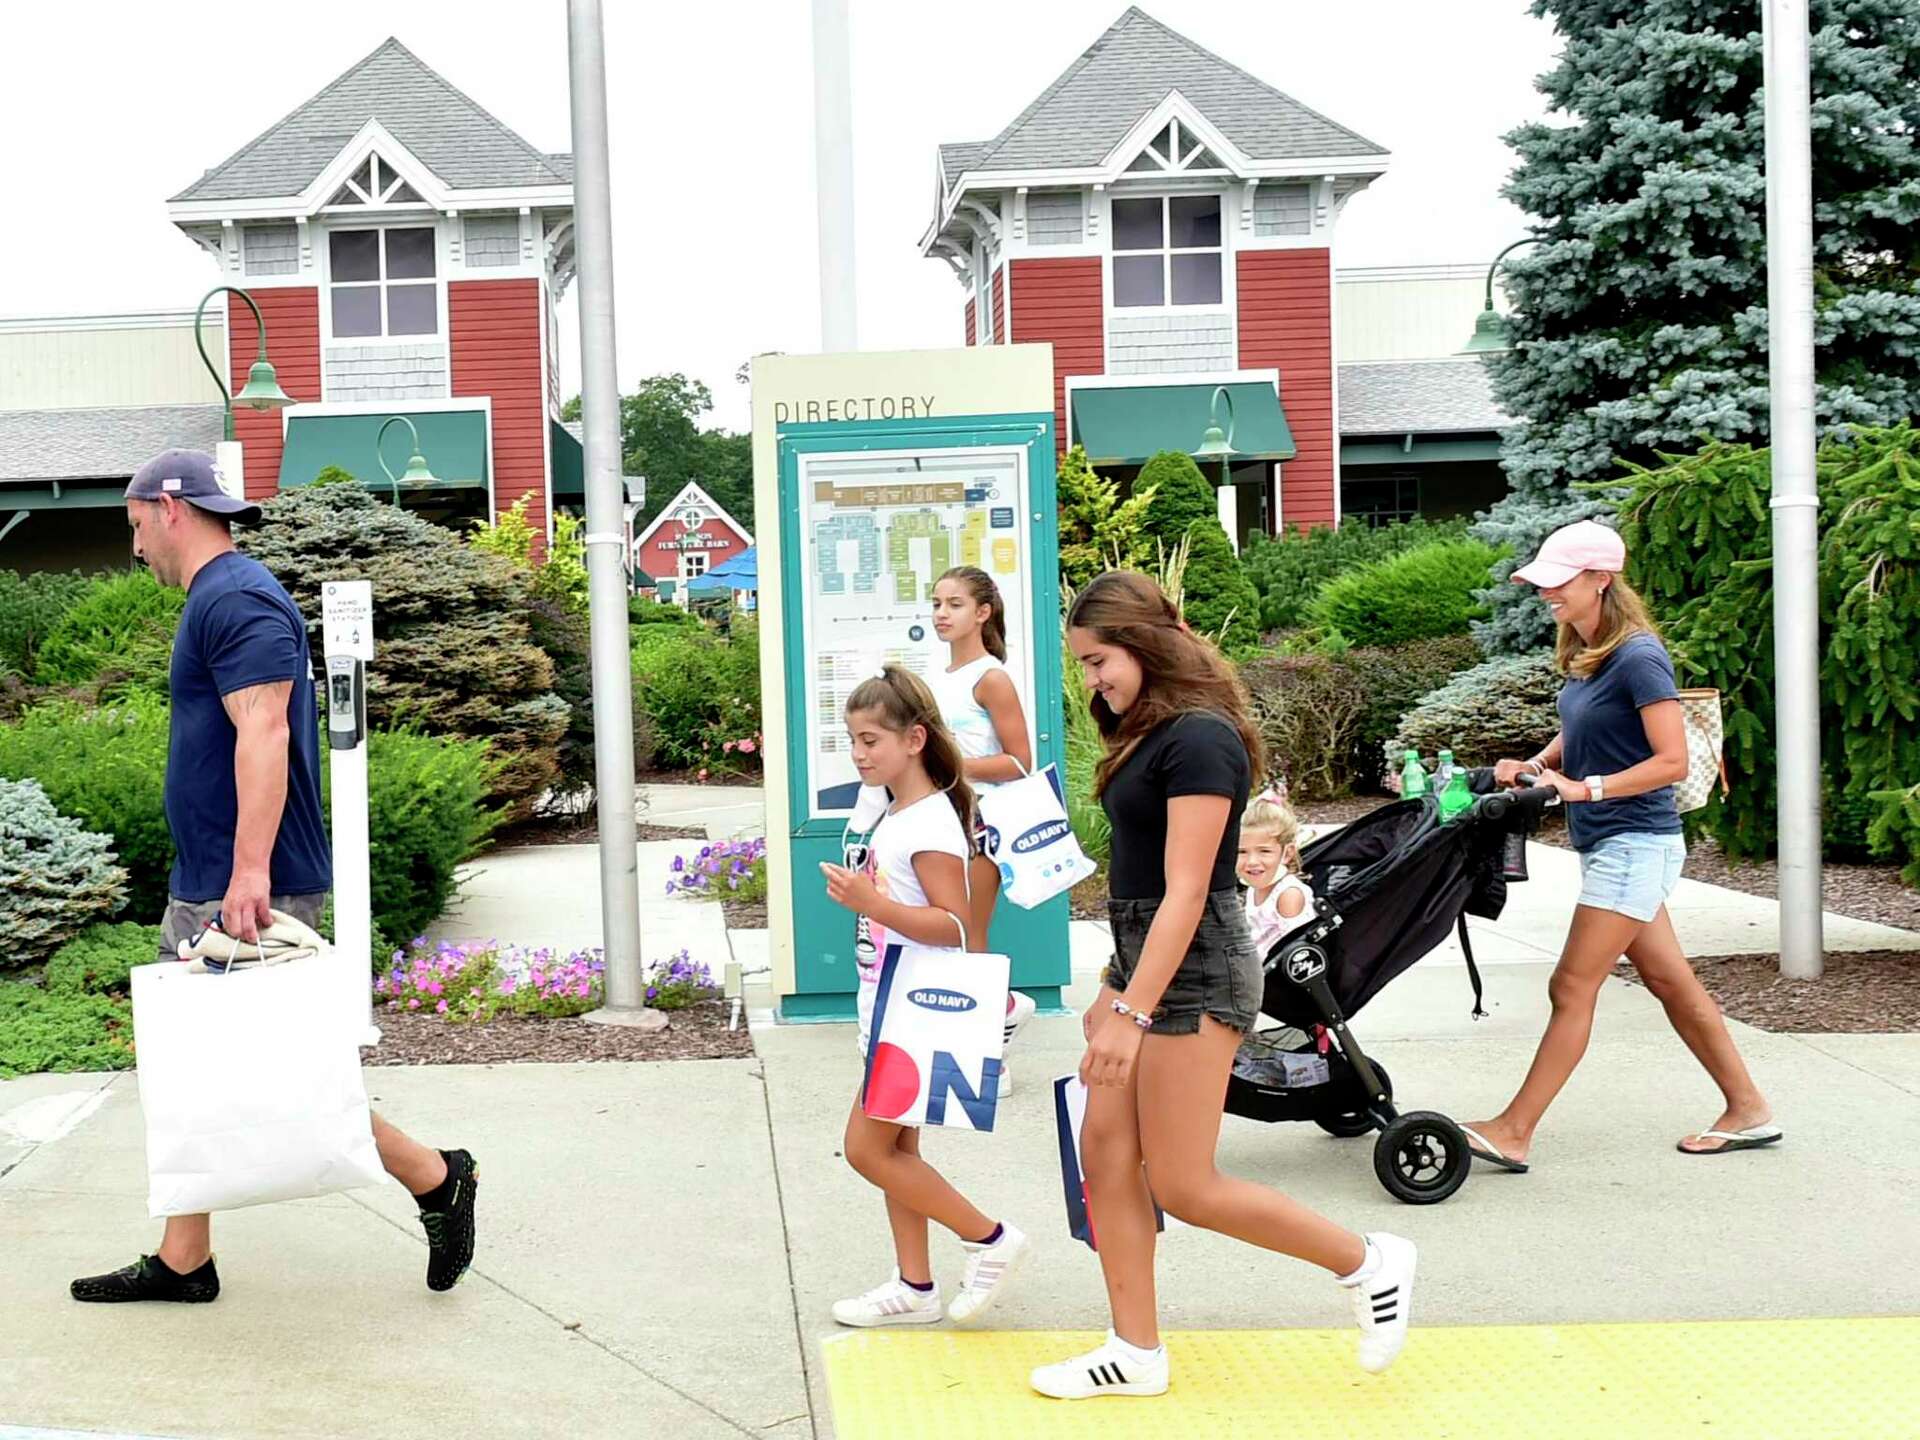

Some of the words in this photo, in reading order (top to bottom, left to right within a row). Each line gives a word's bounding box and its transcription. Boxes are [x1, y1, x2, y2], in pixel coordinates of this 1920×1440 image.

[774, 396, 936, 424] DIRECTORY
[1016, 832, 1040, 850] OLD
[1038, 821, 1068, 842] NAVY
[914, 991, 937, 1006] OLD
[937, 993, 971, 1009] NAVY
